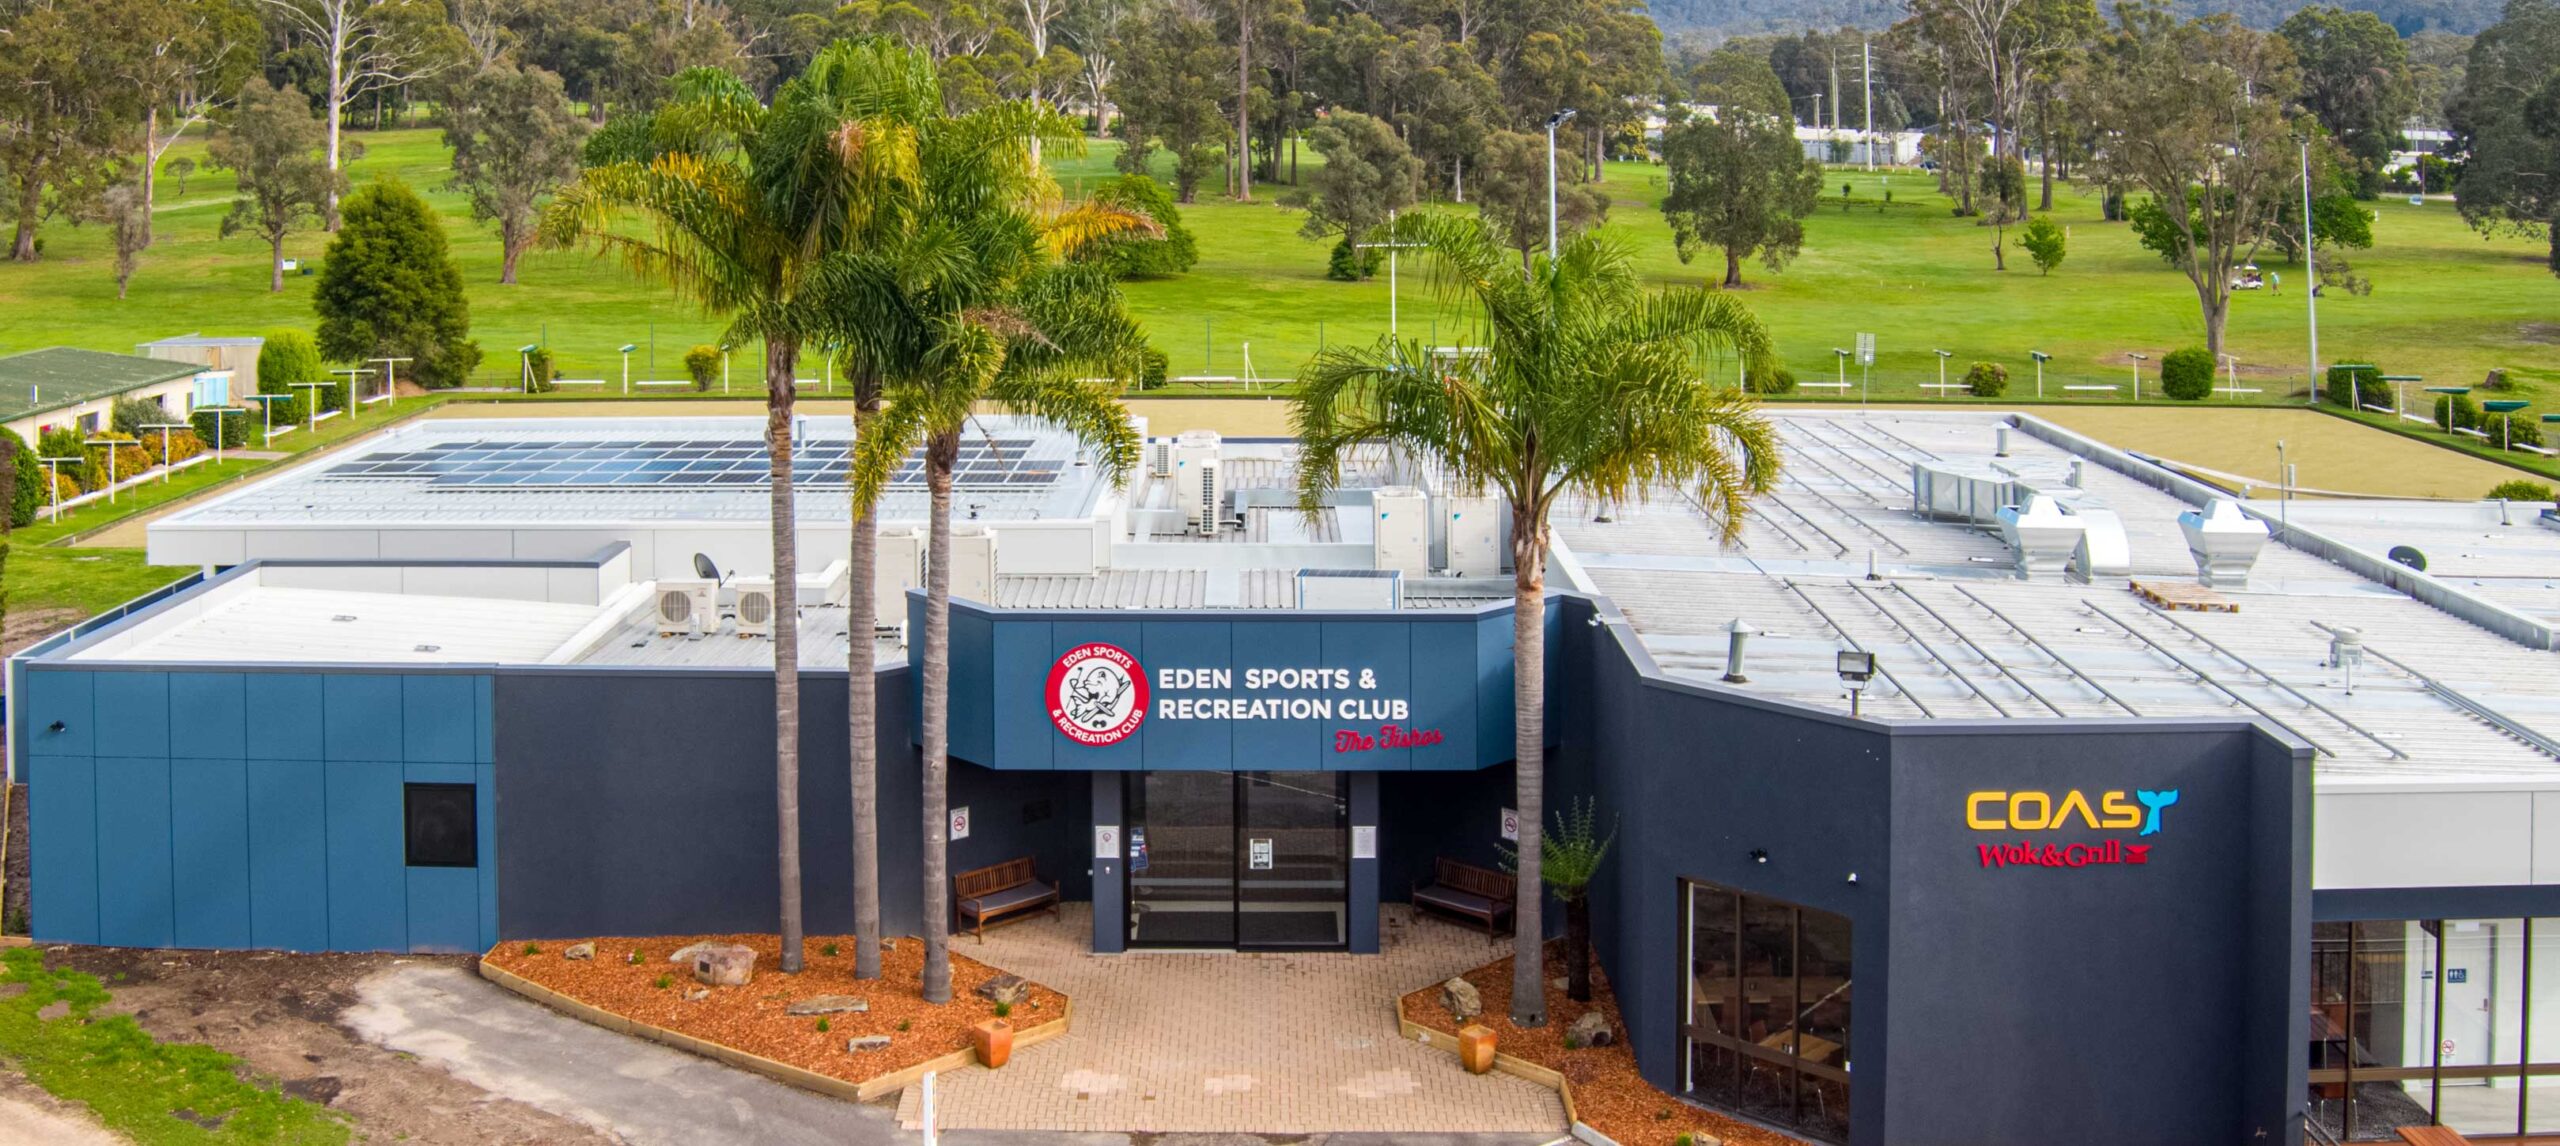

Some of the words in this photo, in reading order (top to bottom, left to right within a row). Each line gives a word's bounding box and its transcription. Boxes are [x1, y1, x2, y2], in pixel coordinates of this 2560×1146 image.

[1062, 648, 1091, 668] EDEN
[1093, 647, 1133, 669] SPORTS
[1158, 668, 1232, 689] EDEN
[1244, 667, 1350, 690] SPORTS
[1358, 667, 1377, 690] &
[1158, 698, 1332, 720] RECREATION
[1338, 698, 1409, 720] CLUB
[1052, 708, 1062, 718] &
[1058, 717, 1122, 744] RECREATION
[1121, 709, 1143, 734] CLUB
[1335, 729, 1376, 753] The
[1966, 788, 2180, 836] COAST
[1977, 839, 2121, 868] Wok&Grill
